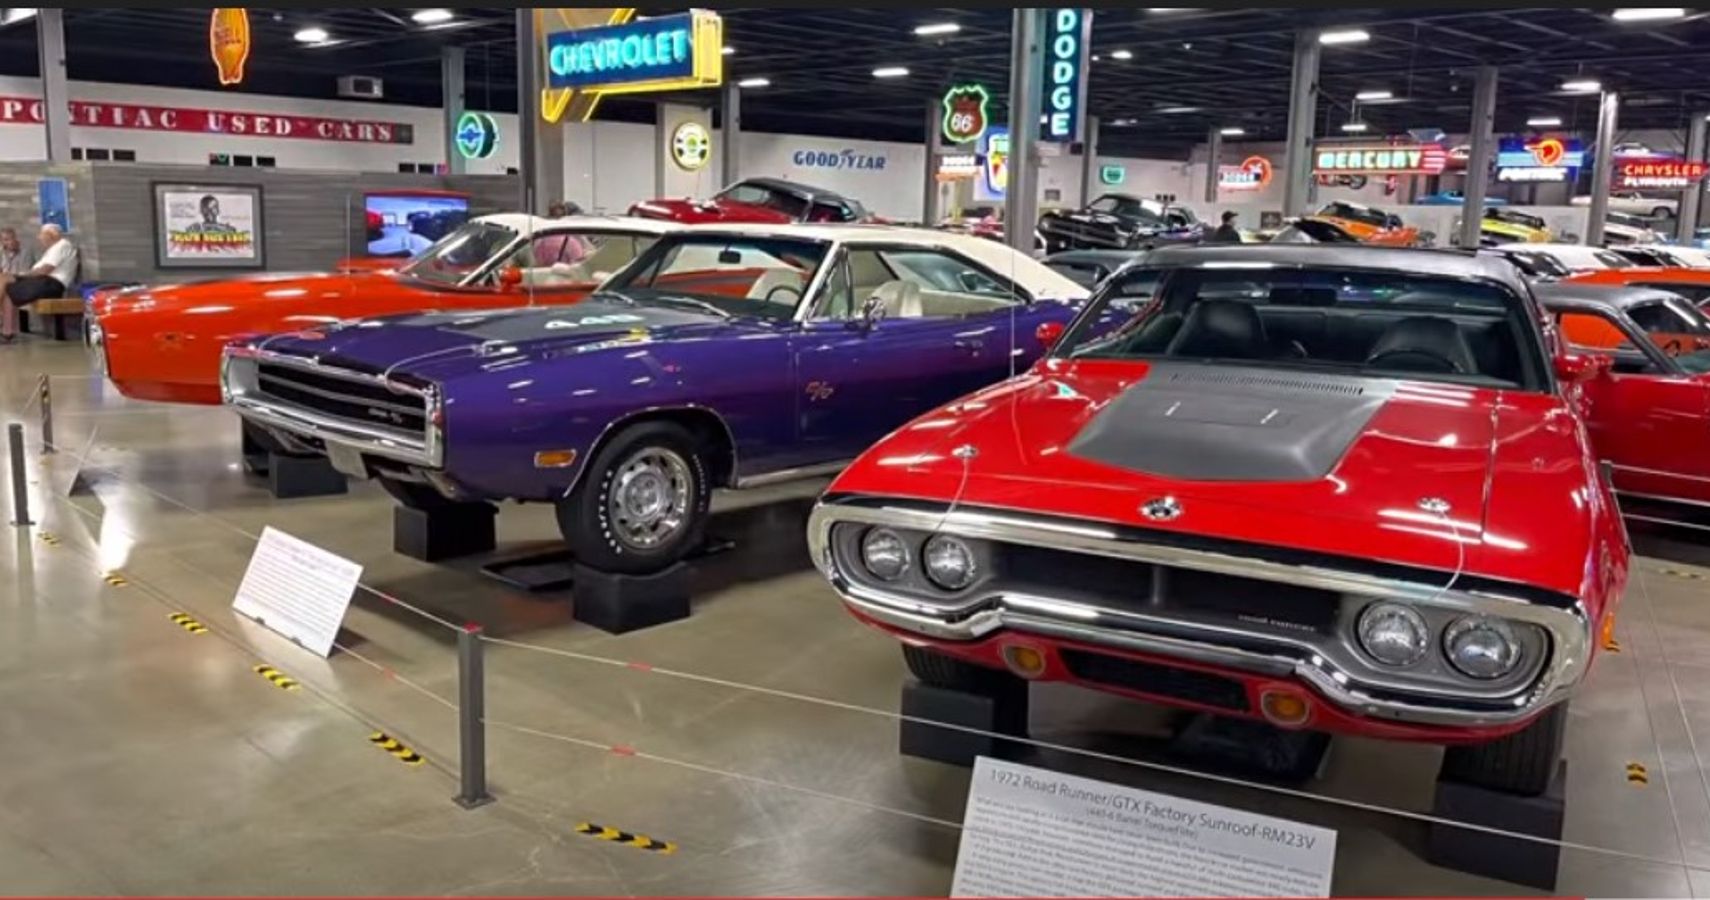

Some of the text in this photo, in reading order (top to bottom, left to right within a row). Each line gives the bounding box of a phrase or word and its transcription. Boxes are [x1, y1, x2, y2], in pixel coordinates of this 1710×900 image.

[550, 29, 687, 76] CHEVROLET
[1051, 8, 1077, 135] DODGE
[3, 101, 177, 128] POTIAC
[207, 112, 292, 135] USED
[951, 112, 974, 133] 66
[1624, 163, 1703, 176] CHRYSLER
[990, 769, 1316, 849] 1972 Road Runner/GTX Factory Sunroof-RM23V
